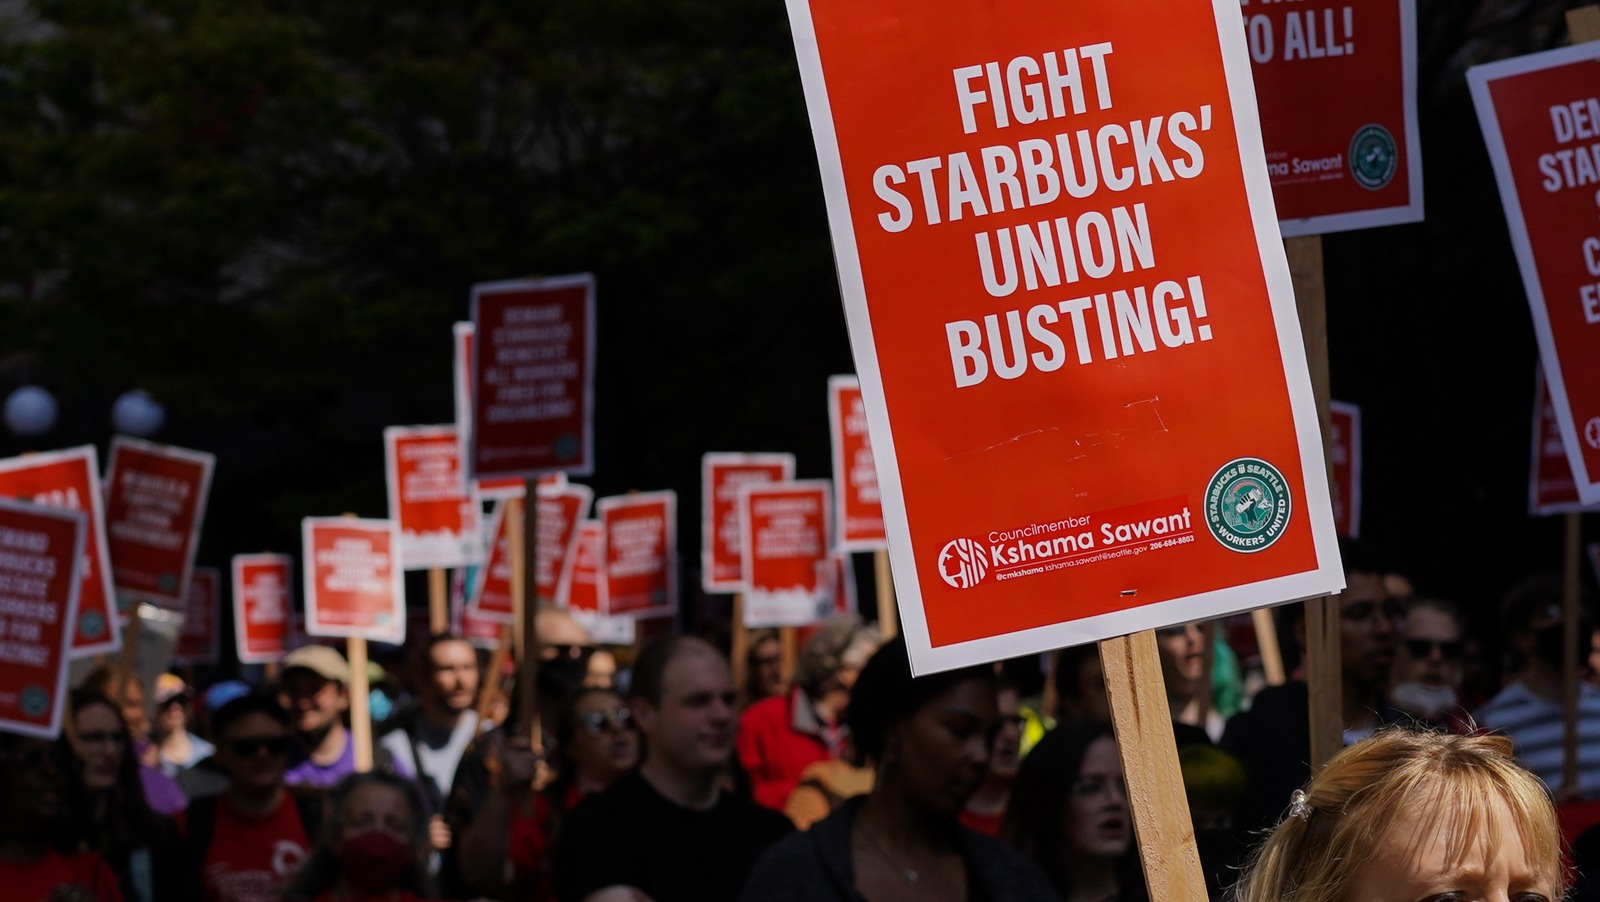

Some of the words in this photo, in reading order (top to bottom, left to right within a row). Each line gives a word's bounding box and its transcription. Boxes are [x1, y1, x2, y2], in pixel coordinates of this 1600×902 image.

[1283, 6, 1355, 62] ALL!
[953, 41, 1114, 135] FIGHT
[1292, 153, 1343, 174] Sawant
[974, 202, 1156, 298] UNION
[945, 275, 1214, 389] BUSTING!
[1209, 467, 1238, 523] STARBUCKS
[1246, 464, 1283, 494] SEATTLE
[988, 514, 1091, 544] Councilmember
[990, 532, 1094, 568] Kshama
[1100, 507, 1191, 545] Sawant
[1218, 525, 1266, 547] WORKERS
[1266, 499, 1286, 538] UNITED
[995, 566, 1044, 581] @cmkshama
[1044, 545, 1148, 572] kshama.sawant@seattle.gov
